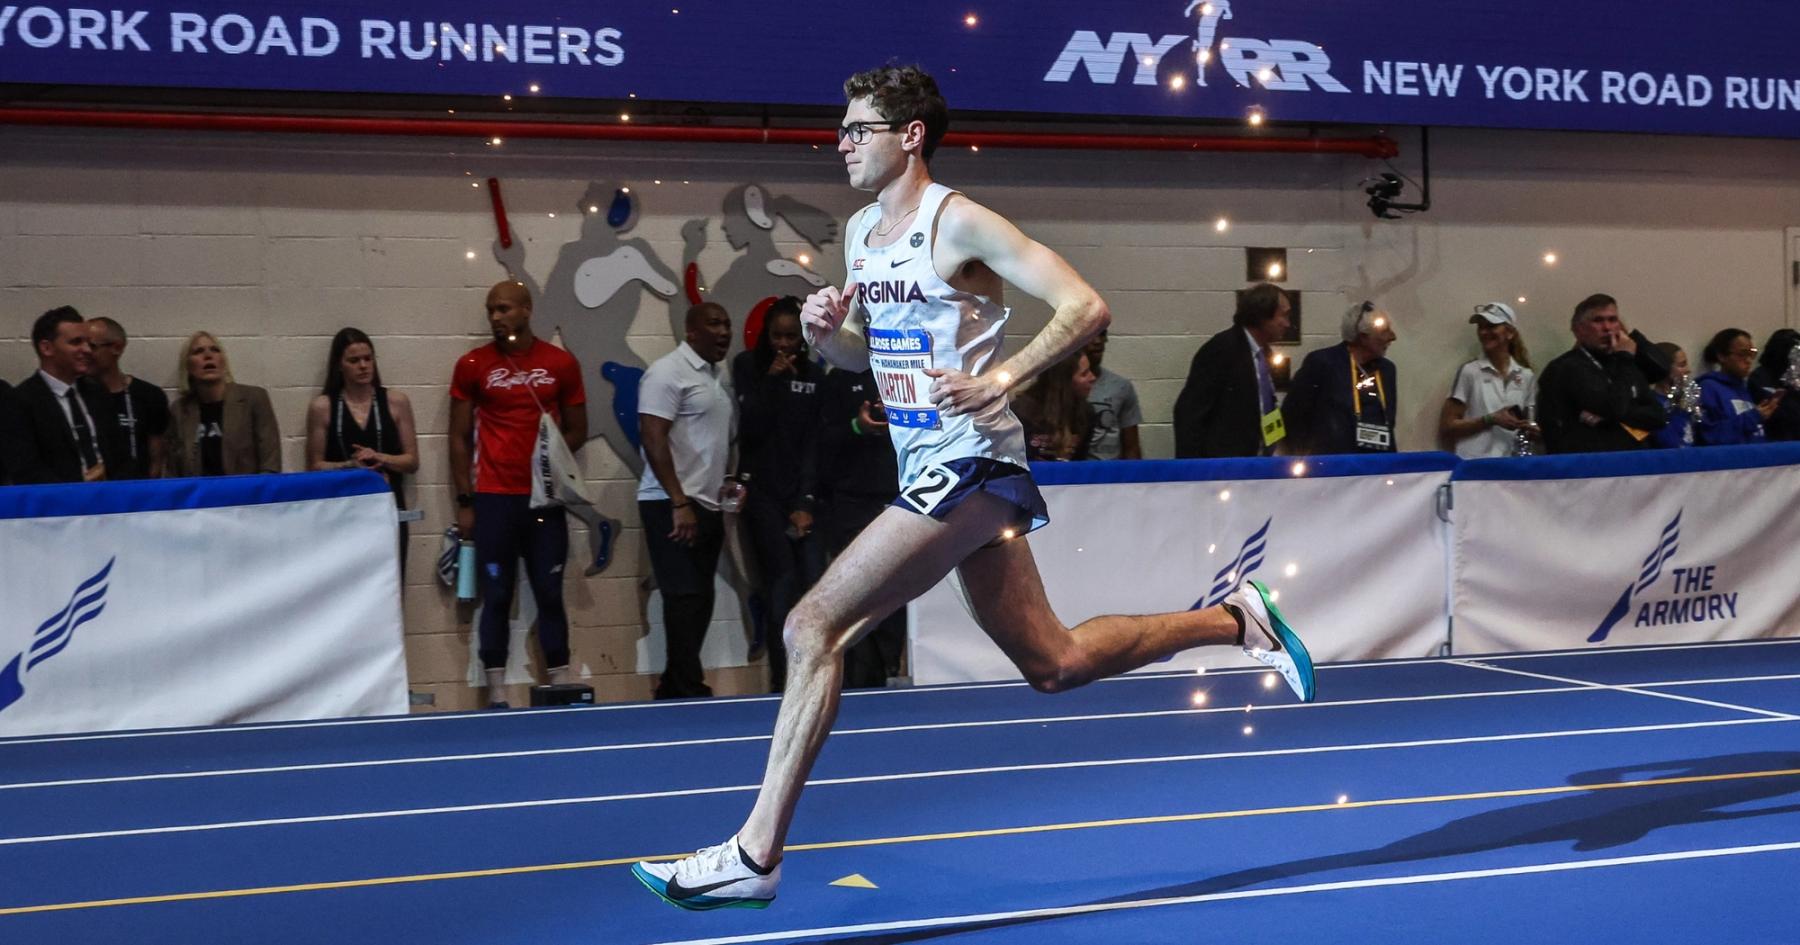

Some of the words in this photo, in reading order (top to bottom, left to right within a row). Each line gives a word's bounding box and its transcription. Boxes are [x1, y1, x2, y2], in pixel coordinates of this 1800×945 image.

[170, 12, 340, 58] ROAD
[361, 19, 625, 67] RUNNERS
[1363, 60, 1464, 98] NEW
[1476, 65, 1590, 103] YORK
[1602, 71, 1713, 108] ROAD
[857, 280, 928, 304] RGINIA
[890, 337, 922, 351] GAMES
[910, 359, 925, 369] MILE
[907, 468, 950, 509] 2
[1672, 565, 1716, 594] THE
[1634, 592, 1738, 628] ARMORY
